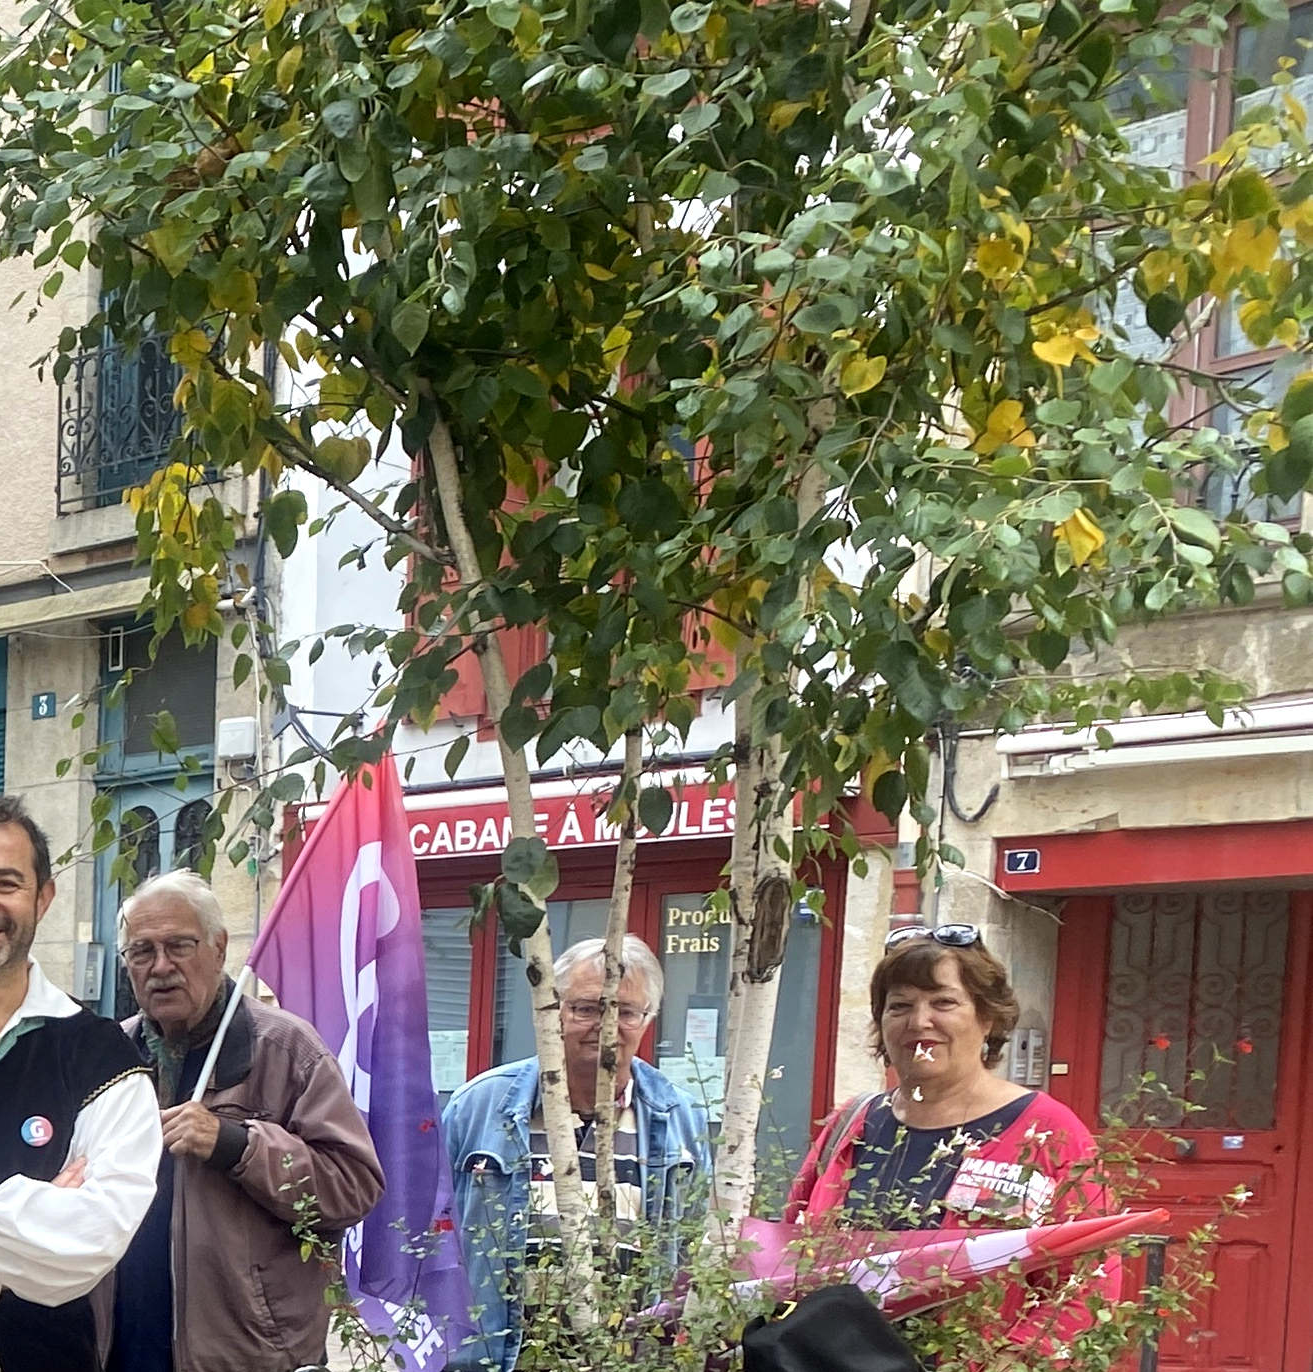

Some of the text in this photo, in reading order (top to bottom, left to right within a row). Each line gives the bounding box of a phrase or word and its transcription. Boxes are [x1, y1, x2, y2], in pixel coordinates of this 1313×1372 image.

[38, 695, 48, 716] 3
[557, 801, 584, 844] À
[594, 798, 736, 842] MLES
[1016, 853, 1030, 870] 7
[665, 932, 720, 954] Frais
